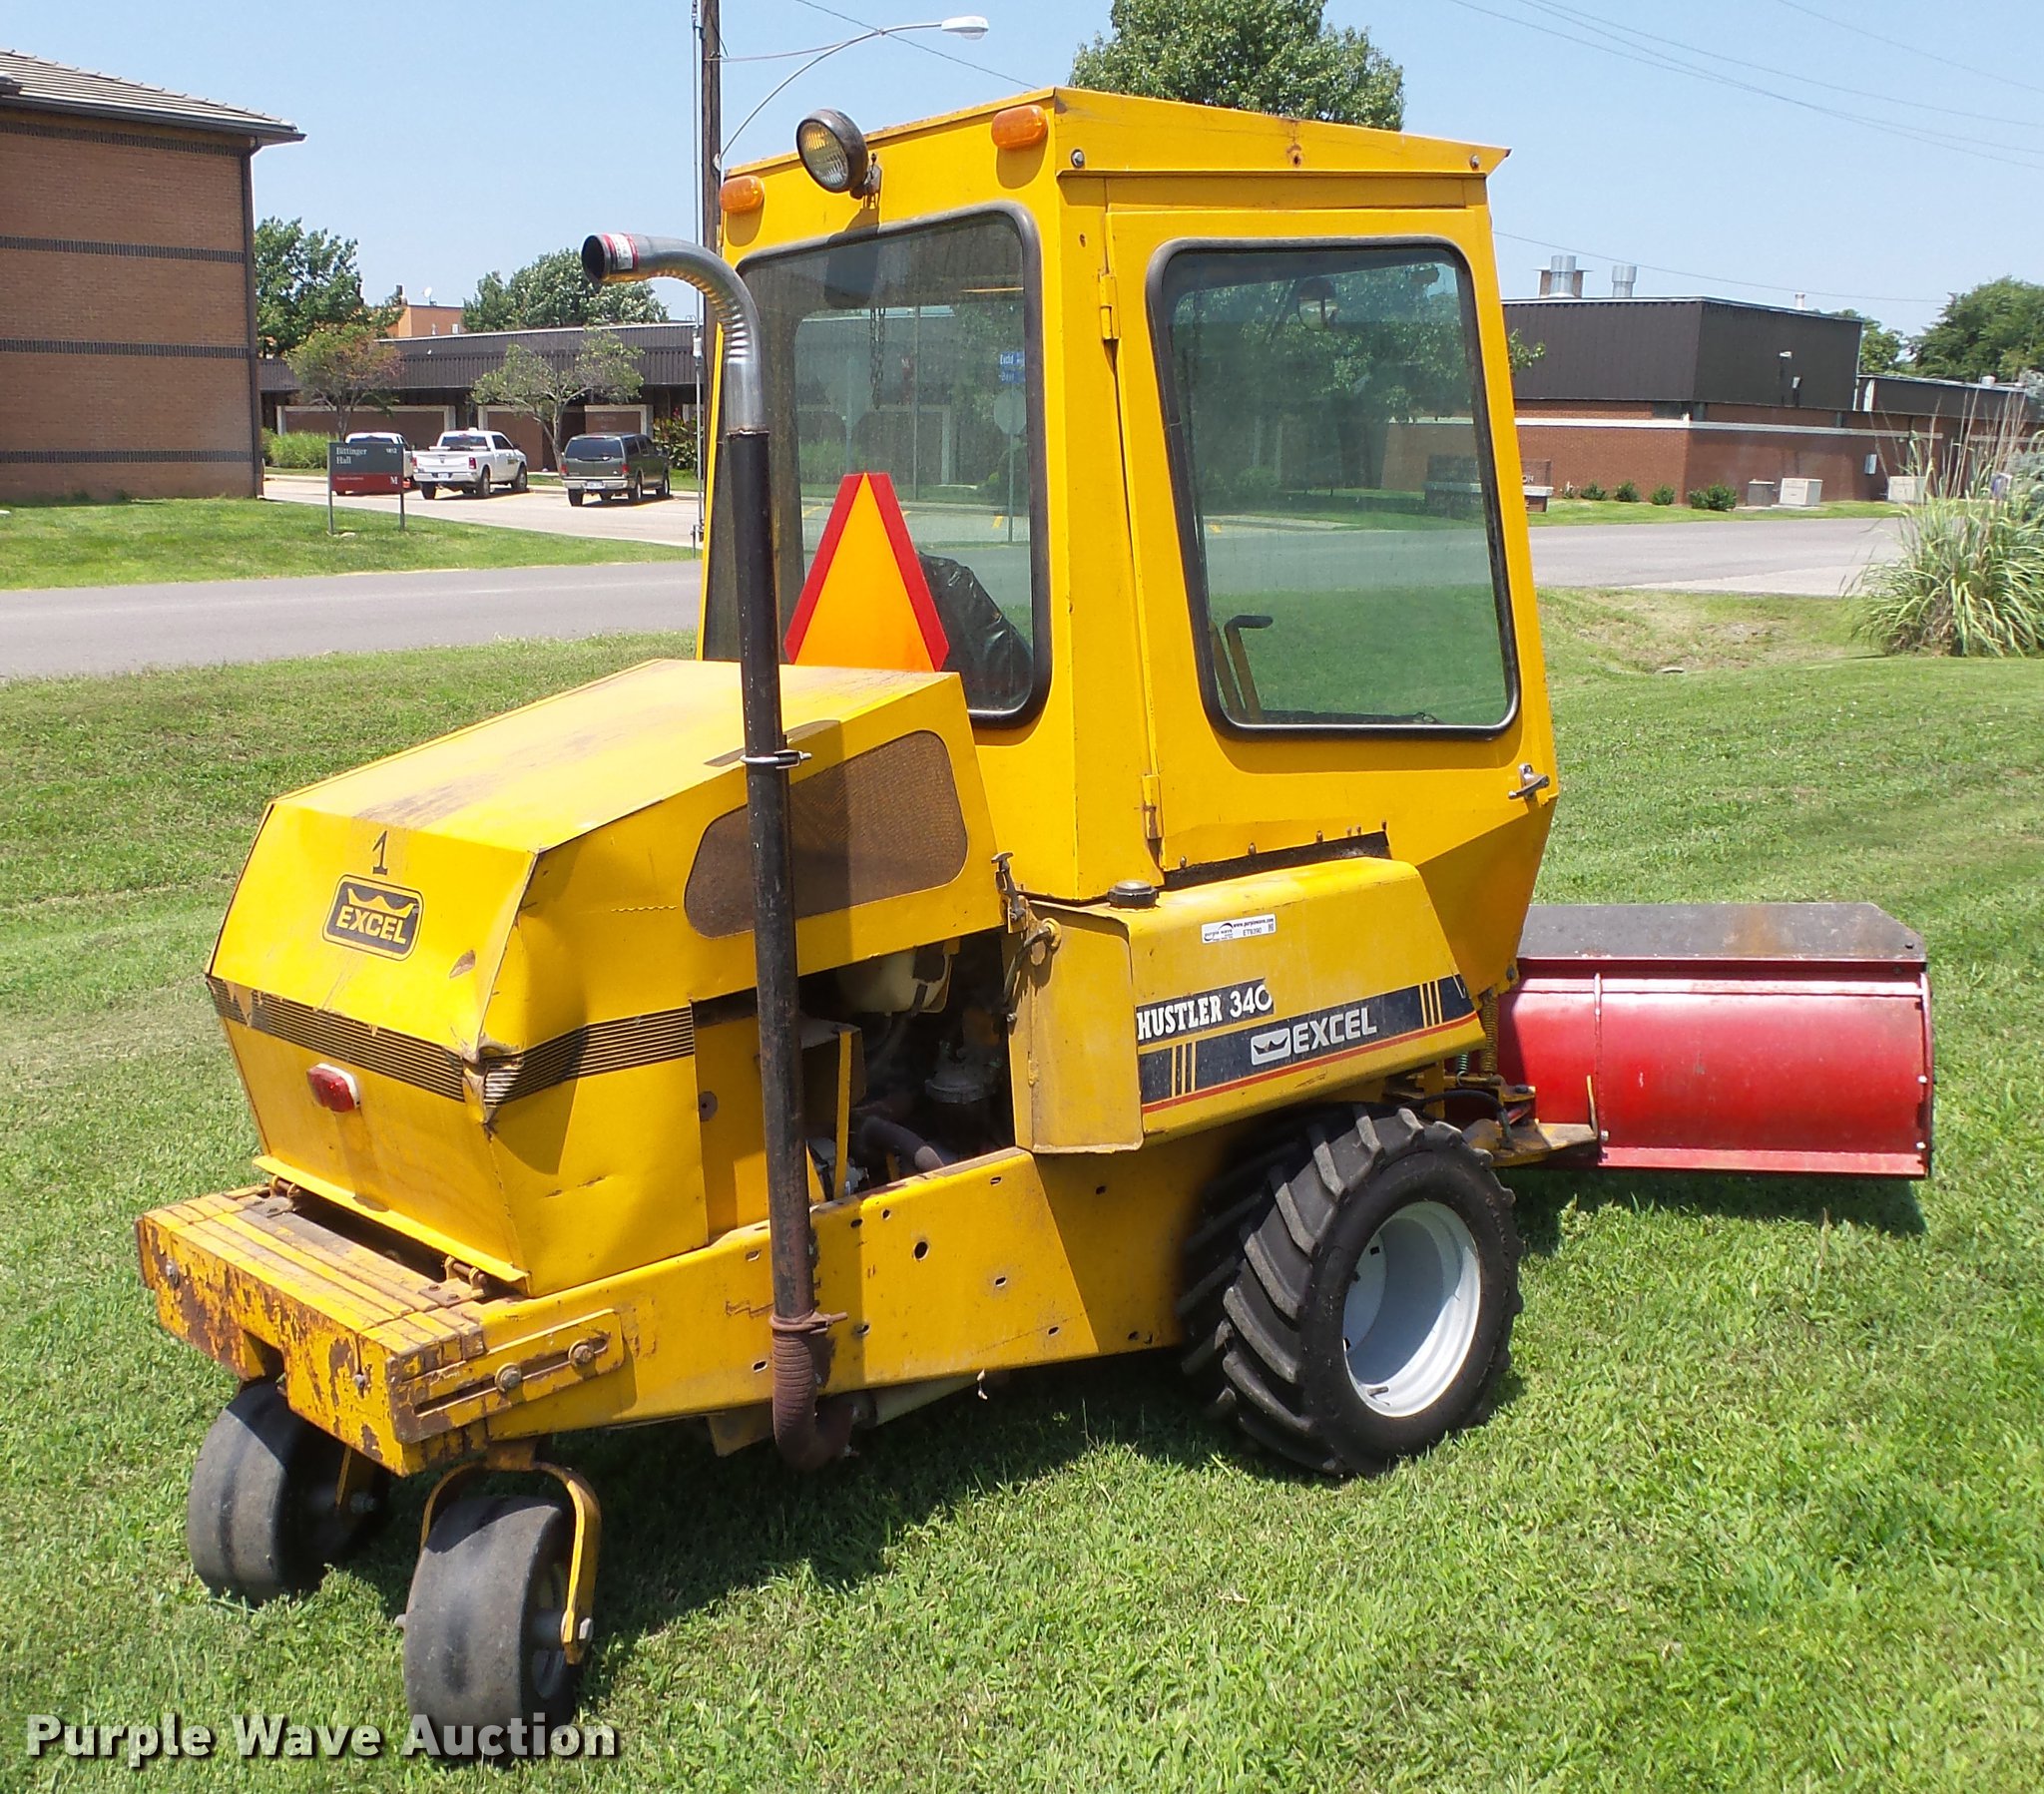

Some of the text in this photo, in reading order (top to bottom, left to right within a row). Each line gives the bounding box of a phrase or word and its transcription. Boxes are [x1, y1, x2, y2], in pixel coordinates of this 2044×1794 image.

[336, 456, 352, 465] Hall
[372, 830, 389, 876] 1
[336, 904, 407, 945] EXCEL
[1136, 984, 1274, 1041] HUSTLER 340
[1292, 1007, 1377, 1055] EXCEL
